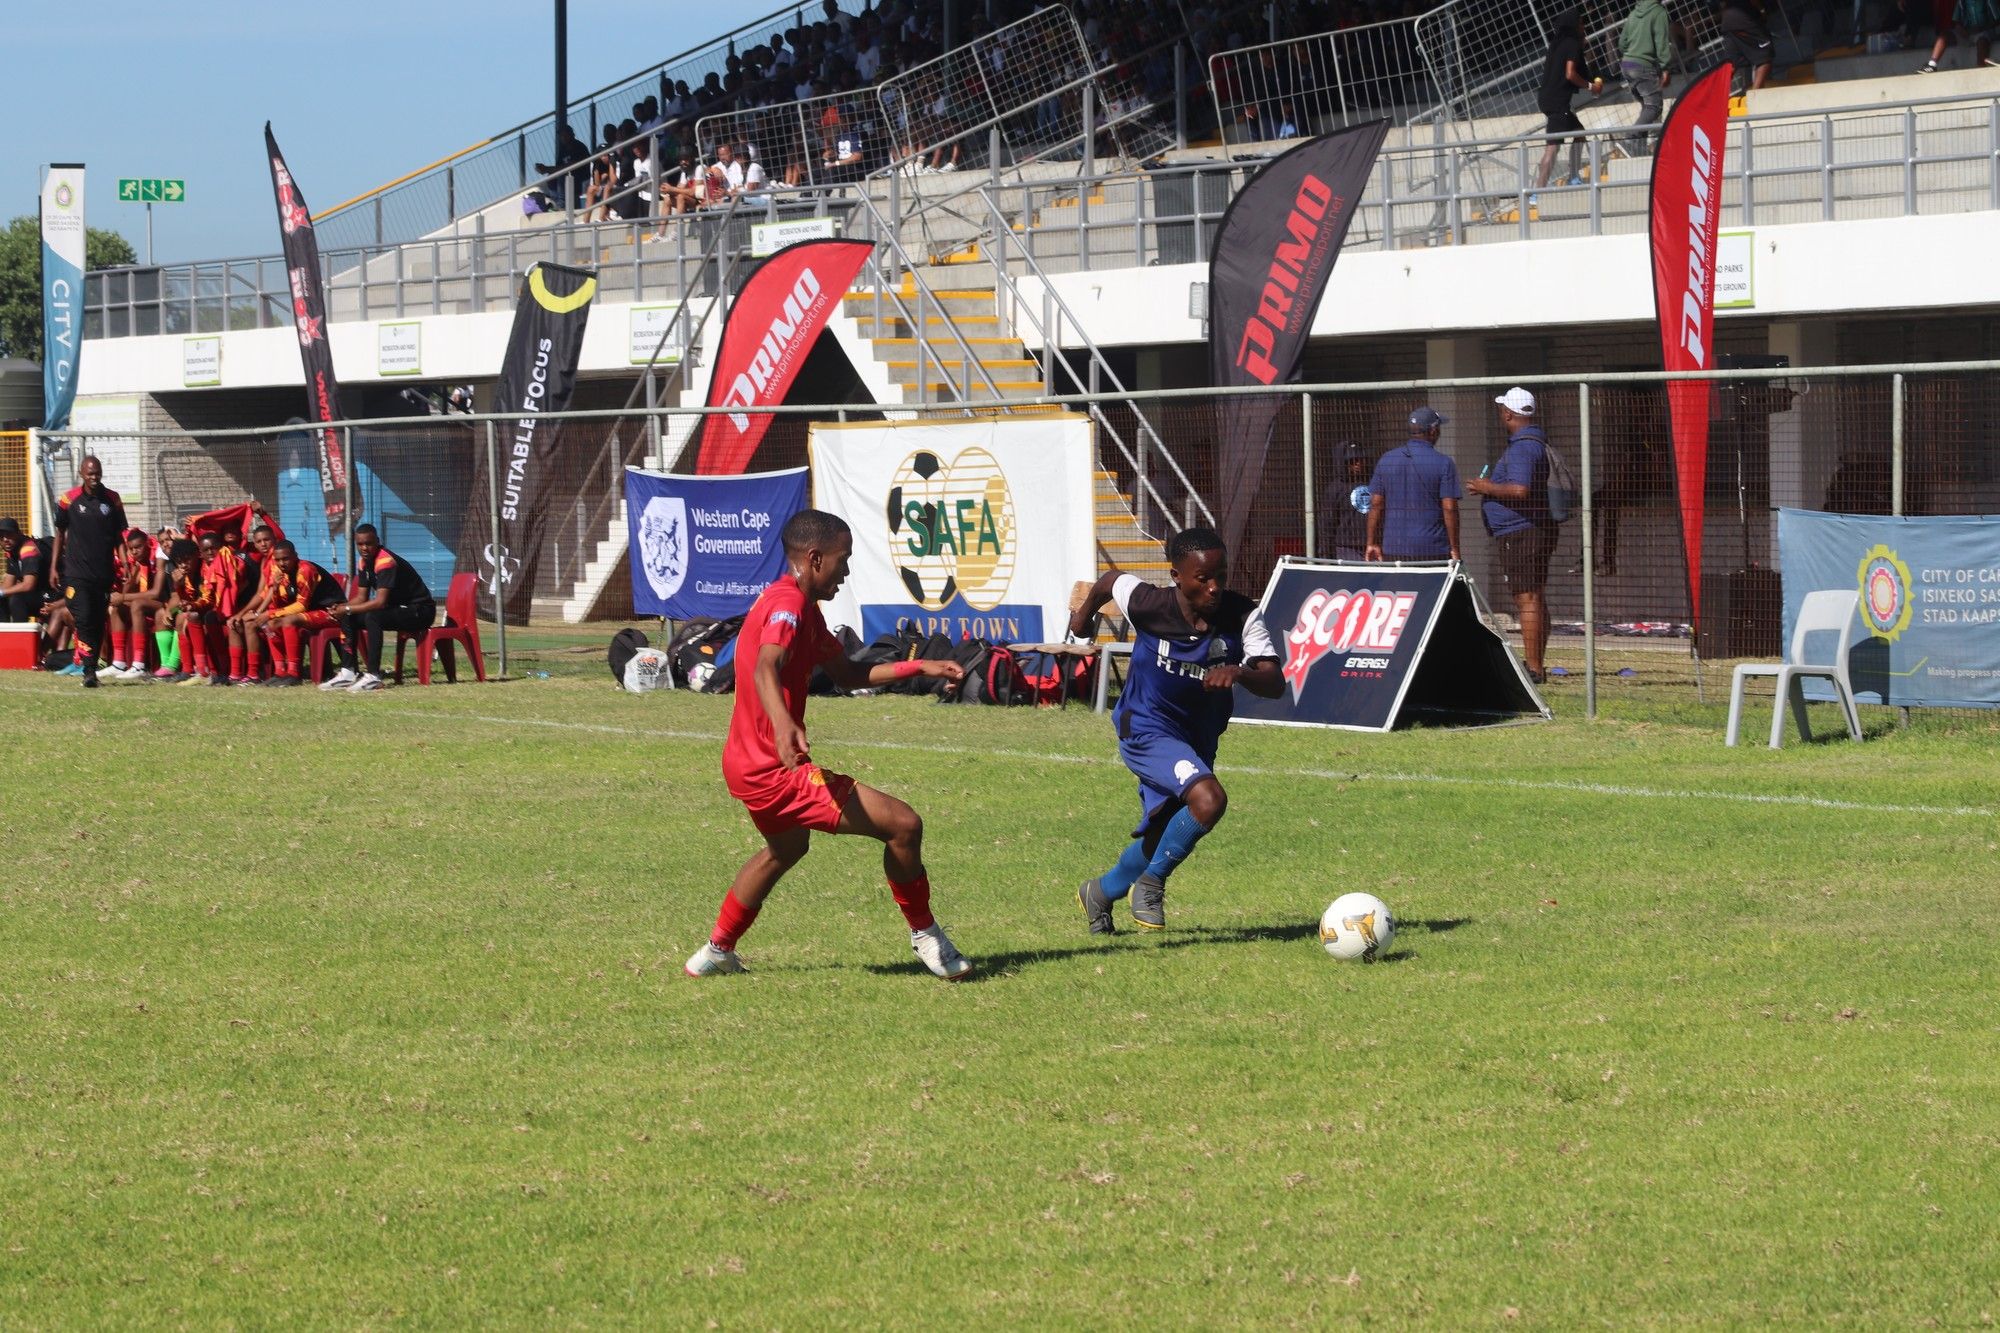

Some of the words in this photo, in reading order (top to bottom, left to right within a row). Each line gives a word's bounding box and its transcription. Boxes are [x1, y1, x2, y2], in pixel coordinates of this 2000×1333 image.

[1681, 124, 1711, 369] PRIMO
[1289, 195, 1345, 335] www.primosport.net
[1724, 264, 1744, 273] PARKS
[1236, 174, 1332, 385] PRIMO
[52, 279, 73, 349] CITY
[722, 267, 820, 434] PRIMO
[764, 292, 829, 400] www.primosport.net
[502, 418, 536, 522] SUITABLE
[523, 338, 552, 412] FOCUS
[691, 508, 739, 528] Western
[741, 508, 771, 531] Cape
[904, 499, 1002, 558] SAFA
[694, 534, 763, 555] Government
[695, 580, 725, 595] Cultural
[726, 580, 749, 595] Affairs
[1921, 569, 1951, 583] CITY
[1955, 569, 1975, 583] OF
[1923, 588, 1976, 603] ISIXEKO
[1289, 591, 1415, 651] SCORE
[1923, 609, 1958, 623] STAD
[958, 617, 1019, 640] TOWN
[1344, 657, 1389, 669] ENERGY
[1927, 667, 1956, 679] Making
[1957, 669, 1991, 679] progress
